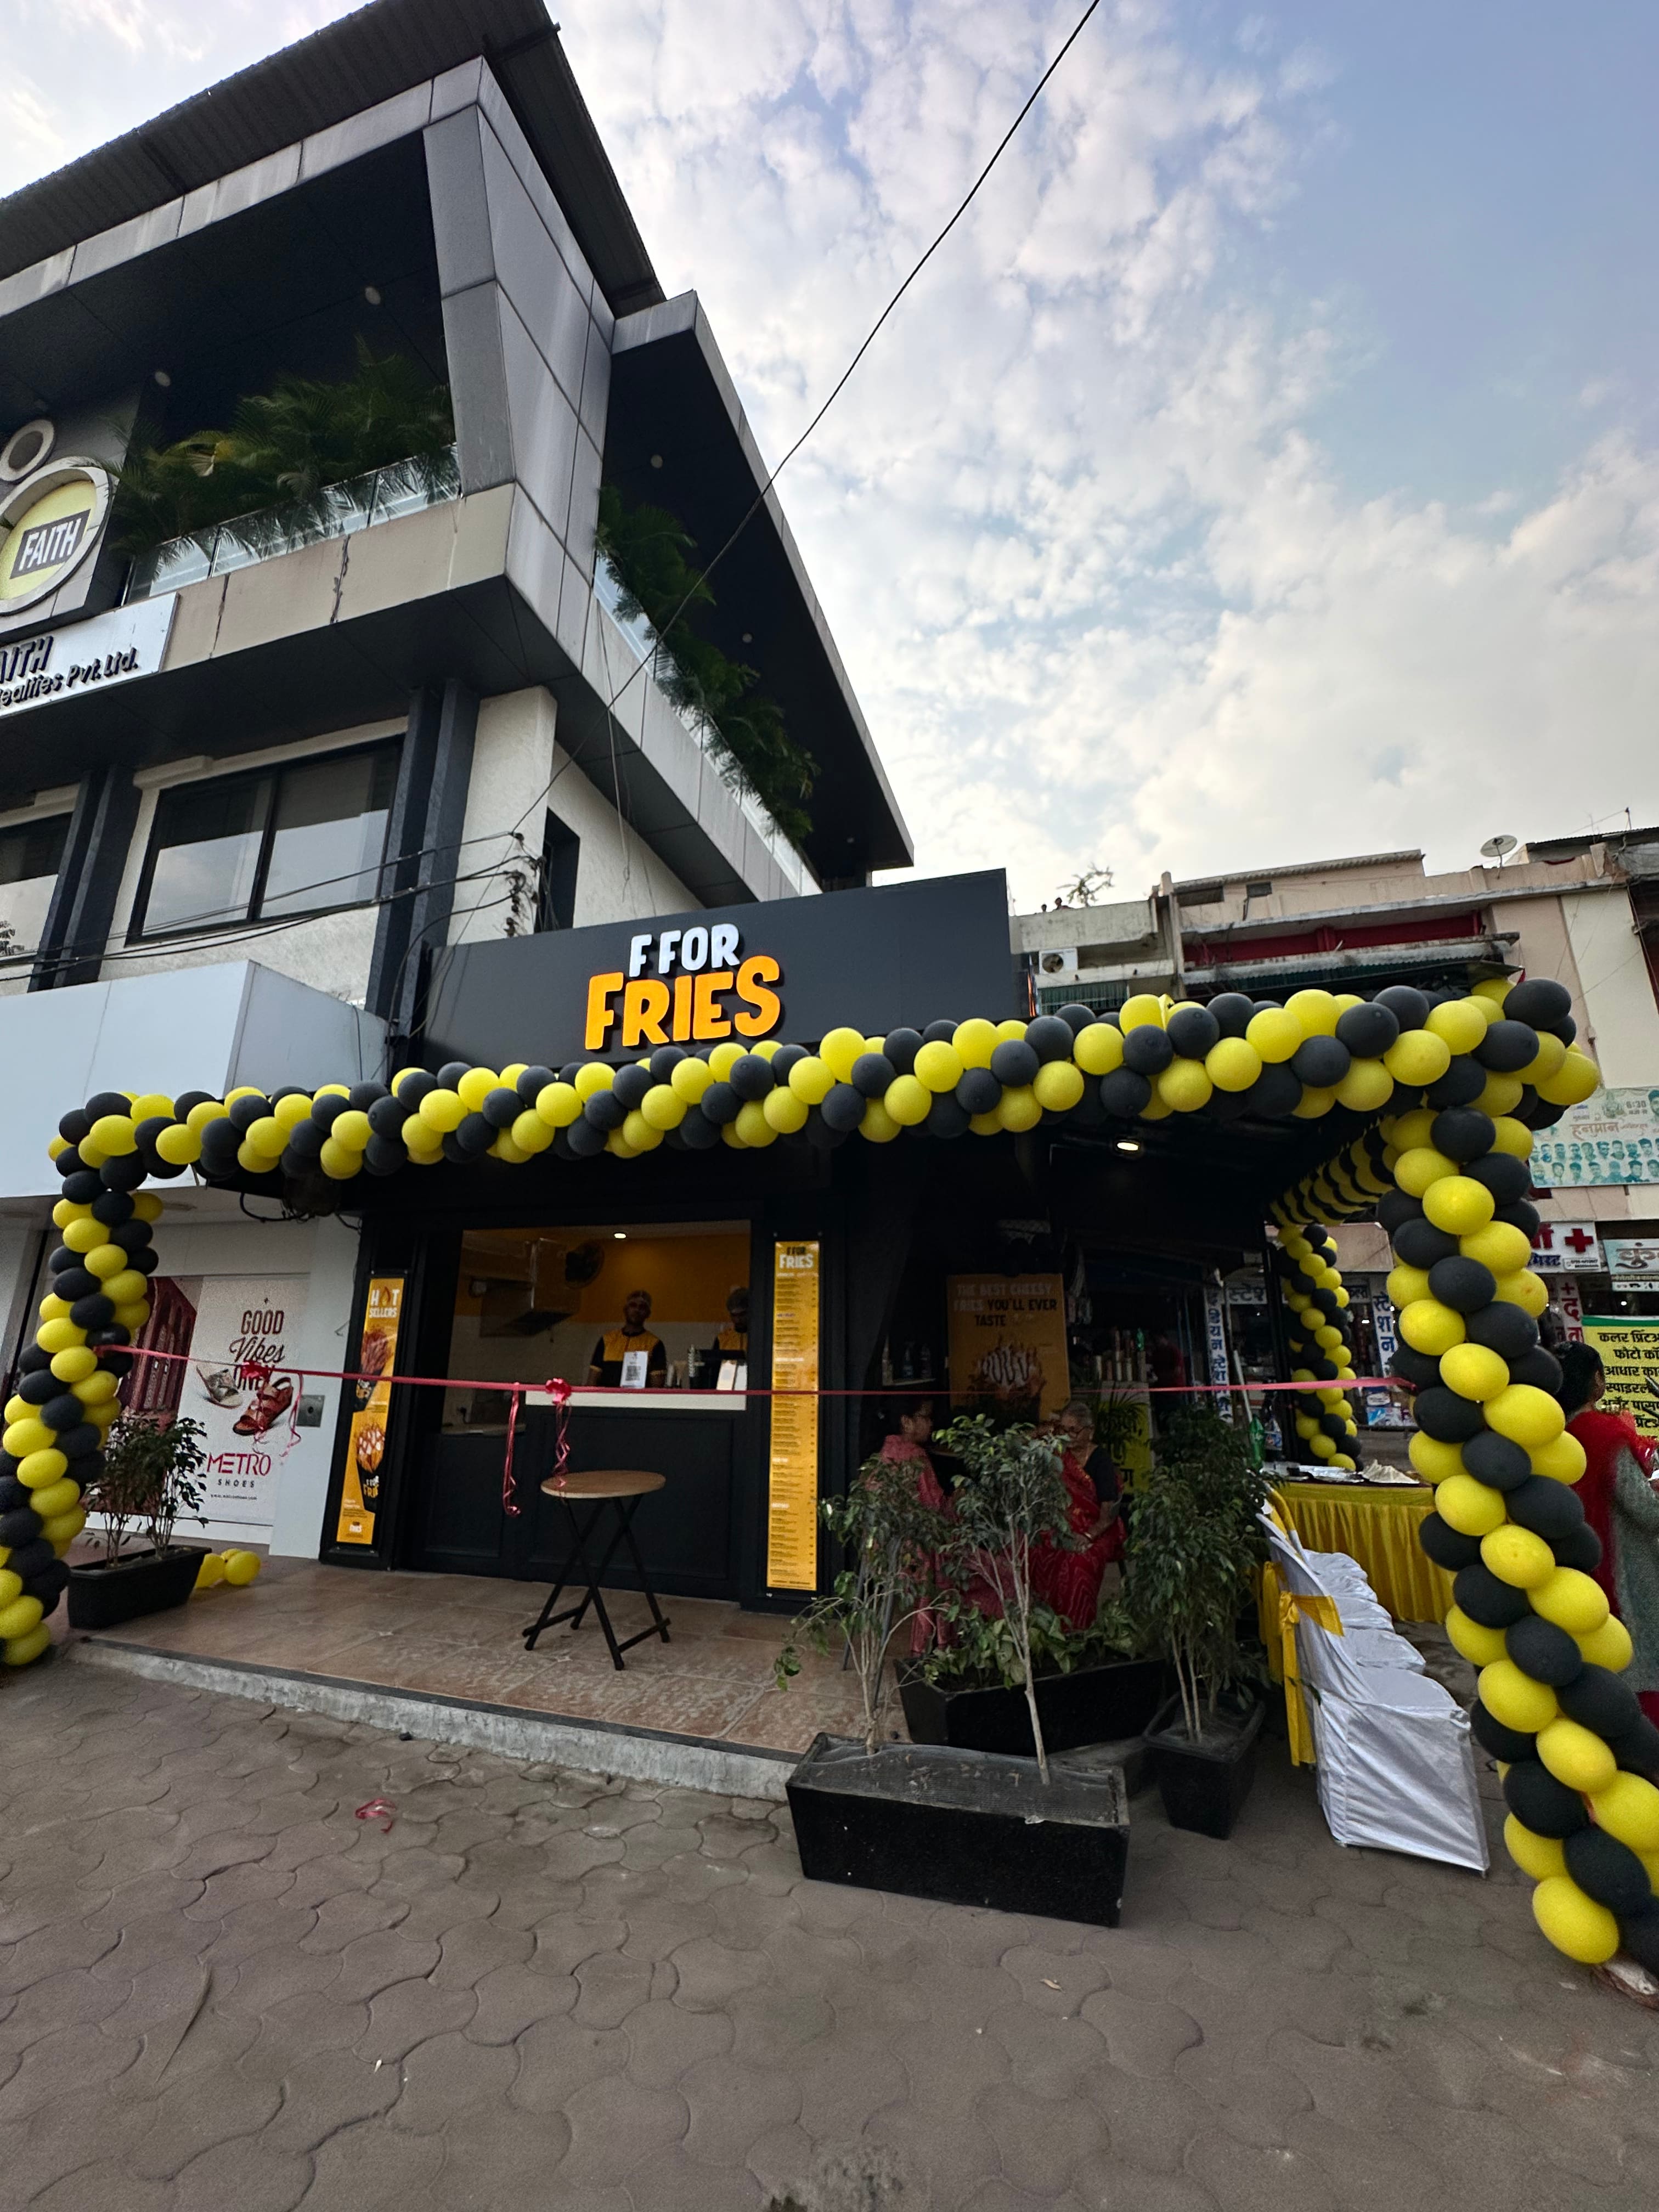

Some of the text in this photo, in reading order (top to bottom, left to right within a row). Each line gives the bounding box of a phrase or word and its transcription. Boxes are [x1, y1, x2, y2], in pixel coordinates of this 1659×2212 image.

[19, 518, 81, 572] FAITH
[66, 658, 101, 688] Pvt.
[103, 646, 139, 678] Ltd.
[629, 923, 740, 978] F FOR
[585, 956, 781, 1050] FRIES
[779, 1253, 814, 1269] FRIES
[979, 1284, 1006, 1296] BEST
[988, 1299, 1024, 1311] YOU'LL
[1028, 1299, 1057, 1311] EVER
[369, 1307, 397, 1318] SELLERS
[241, 1310, 284, 1335] GOOD
[974, 1314, 1006, 1326] TASTE
[1598, 1332, 1629, 1342] कलर
[229, 1335, 285, 1363] Vibes
[1613, 1346, 1641, 1359] फोटो
[1604, 1366, 1640, 1376] आधार
[206, 1452, 271, 1476] METRO
[218, 1478, 255, 1488] SHOES
